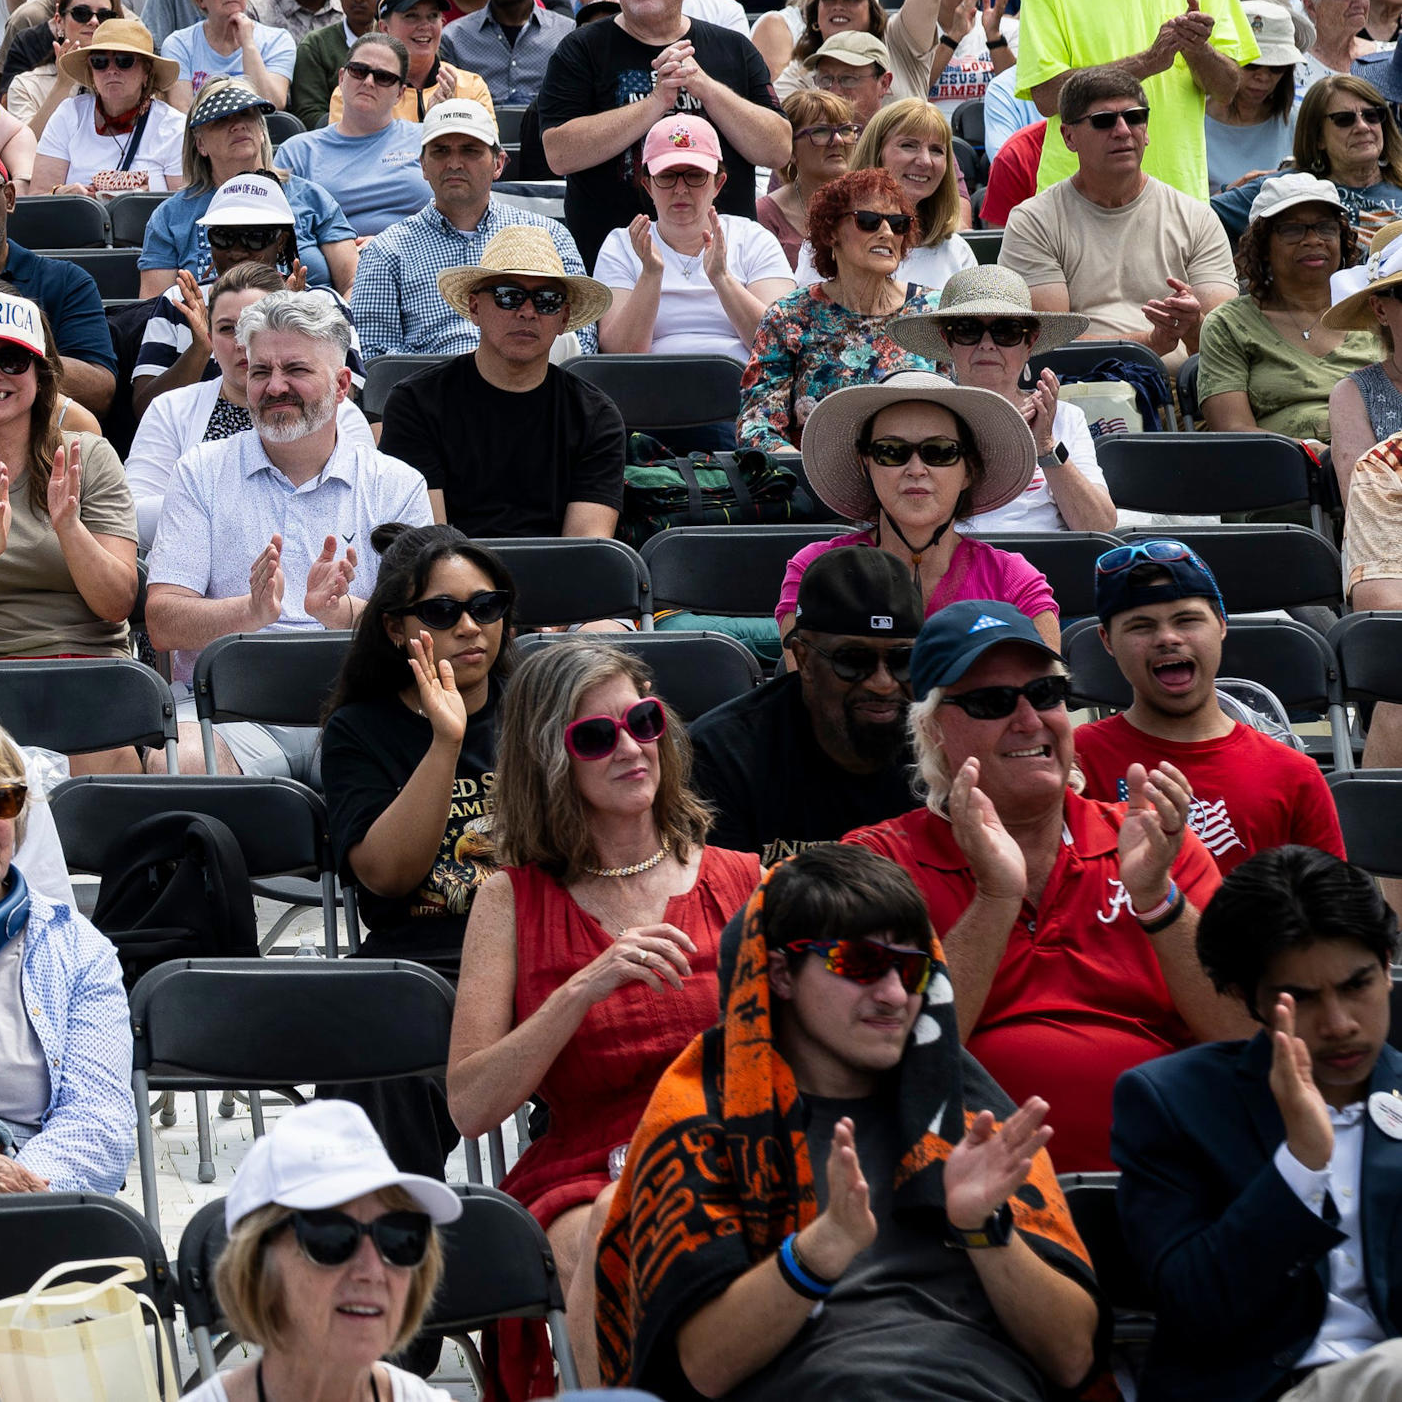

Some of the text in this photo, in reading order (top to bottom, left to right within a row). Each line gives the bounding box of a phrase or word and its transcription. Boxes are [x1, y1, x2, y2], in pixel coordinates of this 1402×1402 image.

[939, 73, 976, 85] ESUS
[940, 85, 986, 97] AMER
[223, 184, 269, 197] WOMAN OF FAITH
